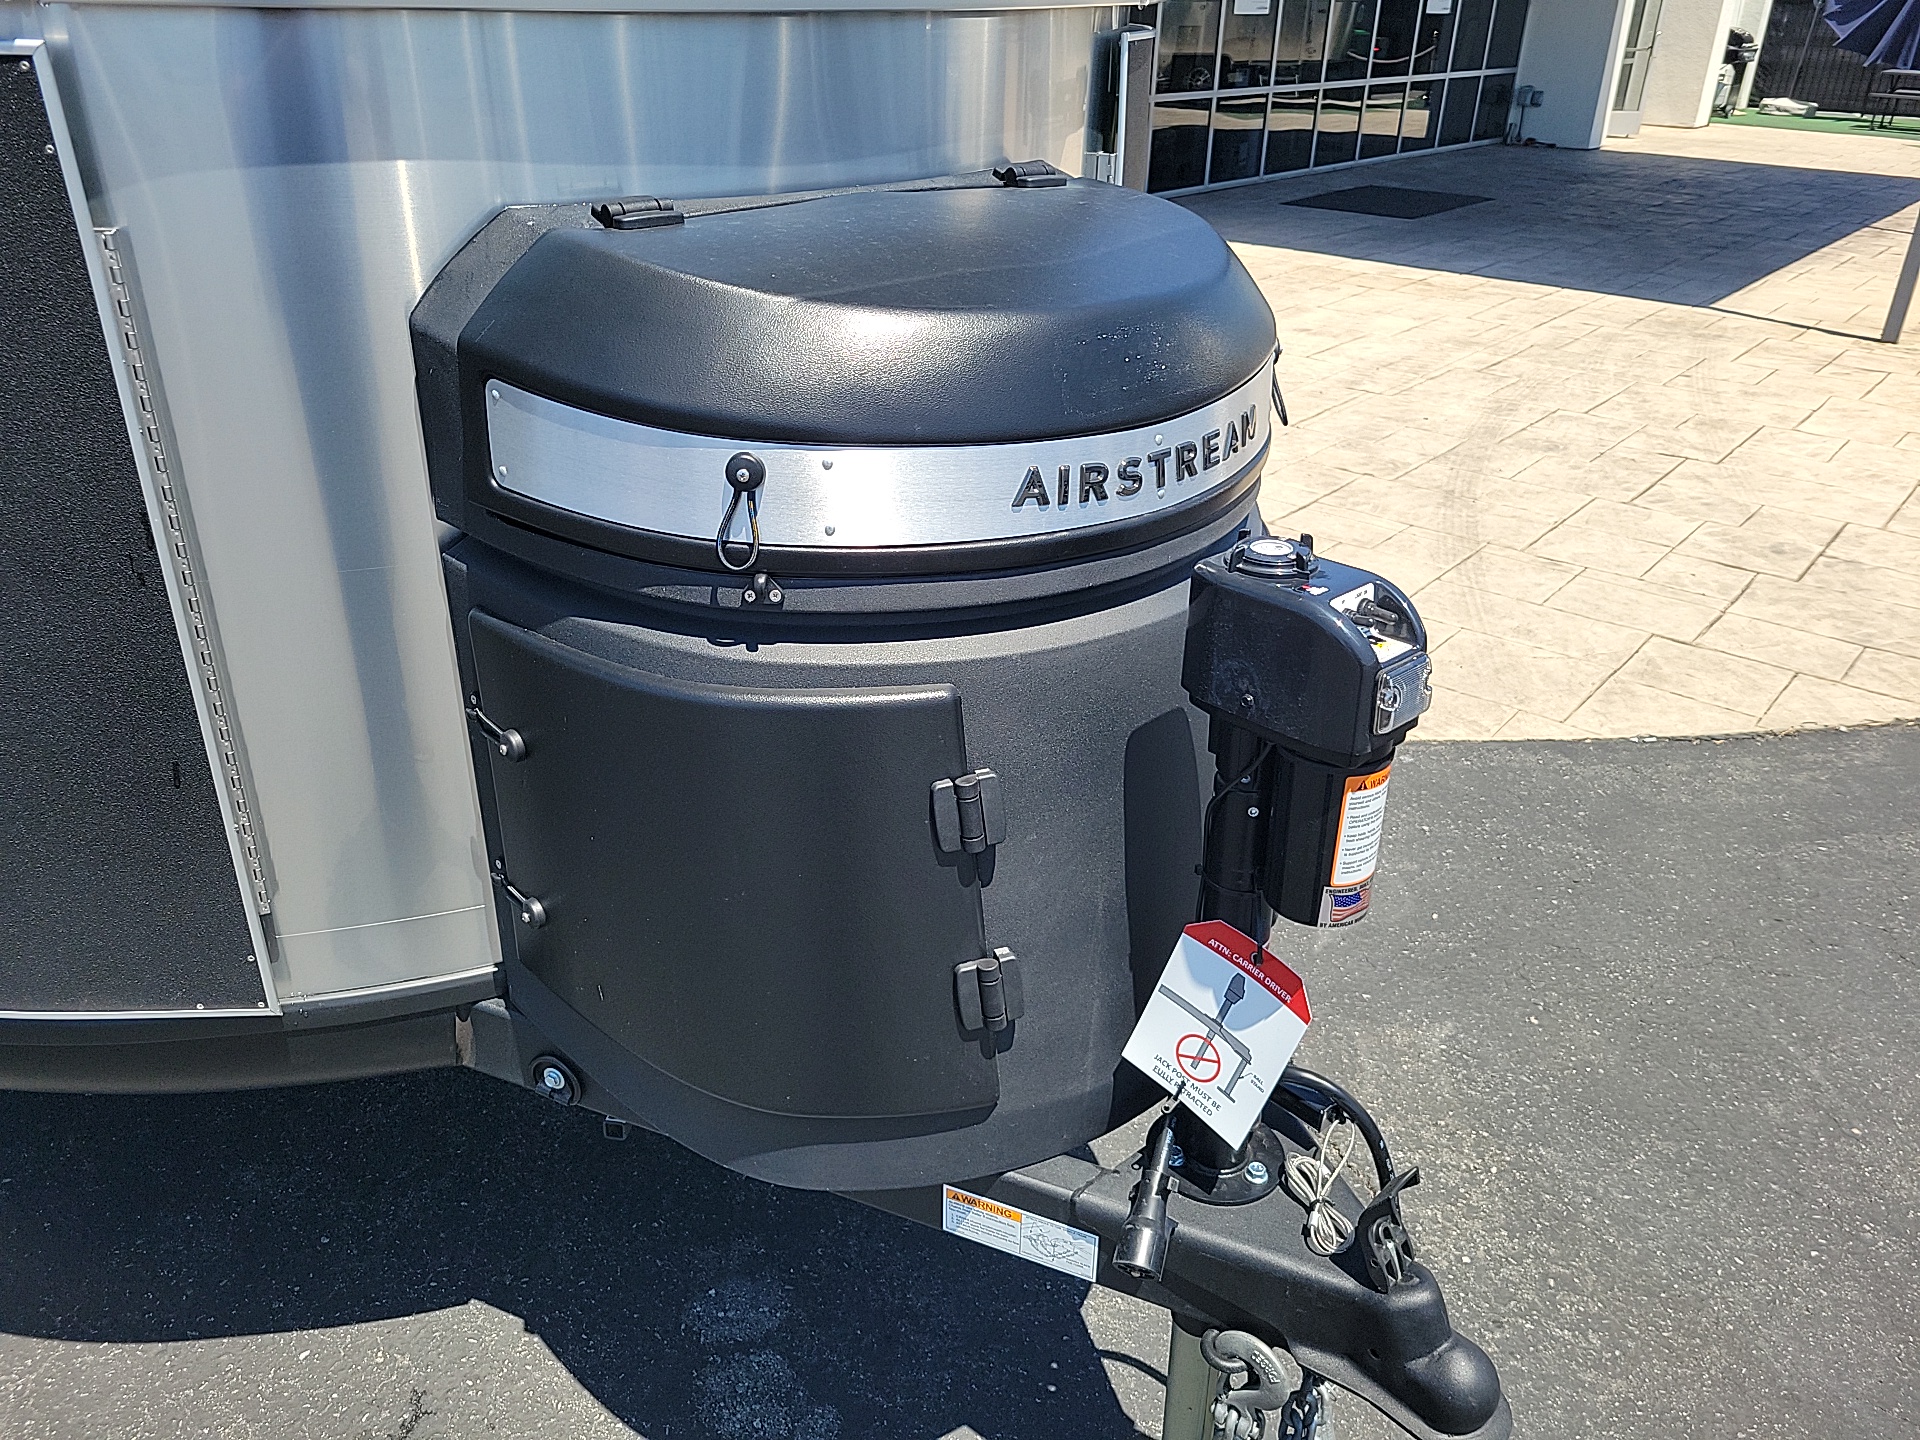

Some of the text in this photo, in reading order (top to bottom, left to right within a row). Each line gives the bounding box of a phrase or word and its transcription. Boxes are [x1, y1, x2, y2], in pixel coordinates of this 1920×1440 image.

[1011, 404, 1257, 508] AIRSTREAM
[1208, 938, 1292, 1004] ATTN: CARRIER DRIVER
[1152, 1065, 1213, 1117] FULLY RTRACTED
[1153, 1054, 1171, 1071] JACK
[1190, 1082, 1212, 1103] MUST
[1211, 1100, 1222, 1112] BE
[961, 1194, 1012, 1218] WARNING
